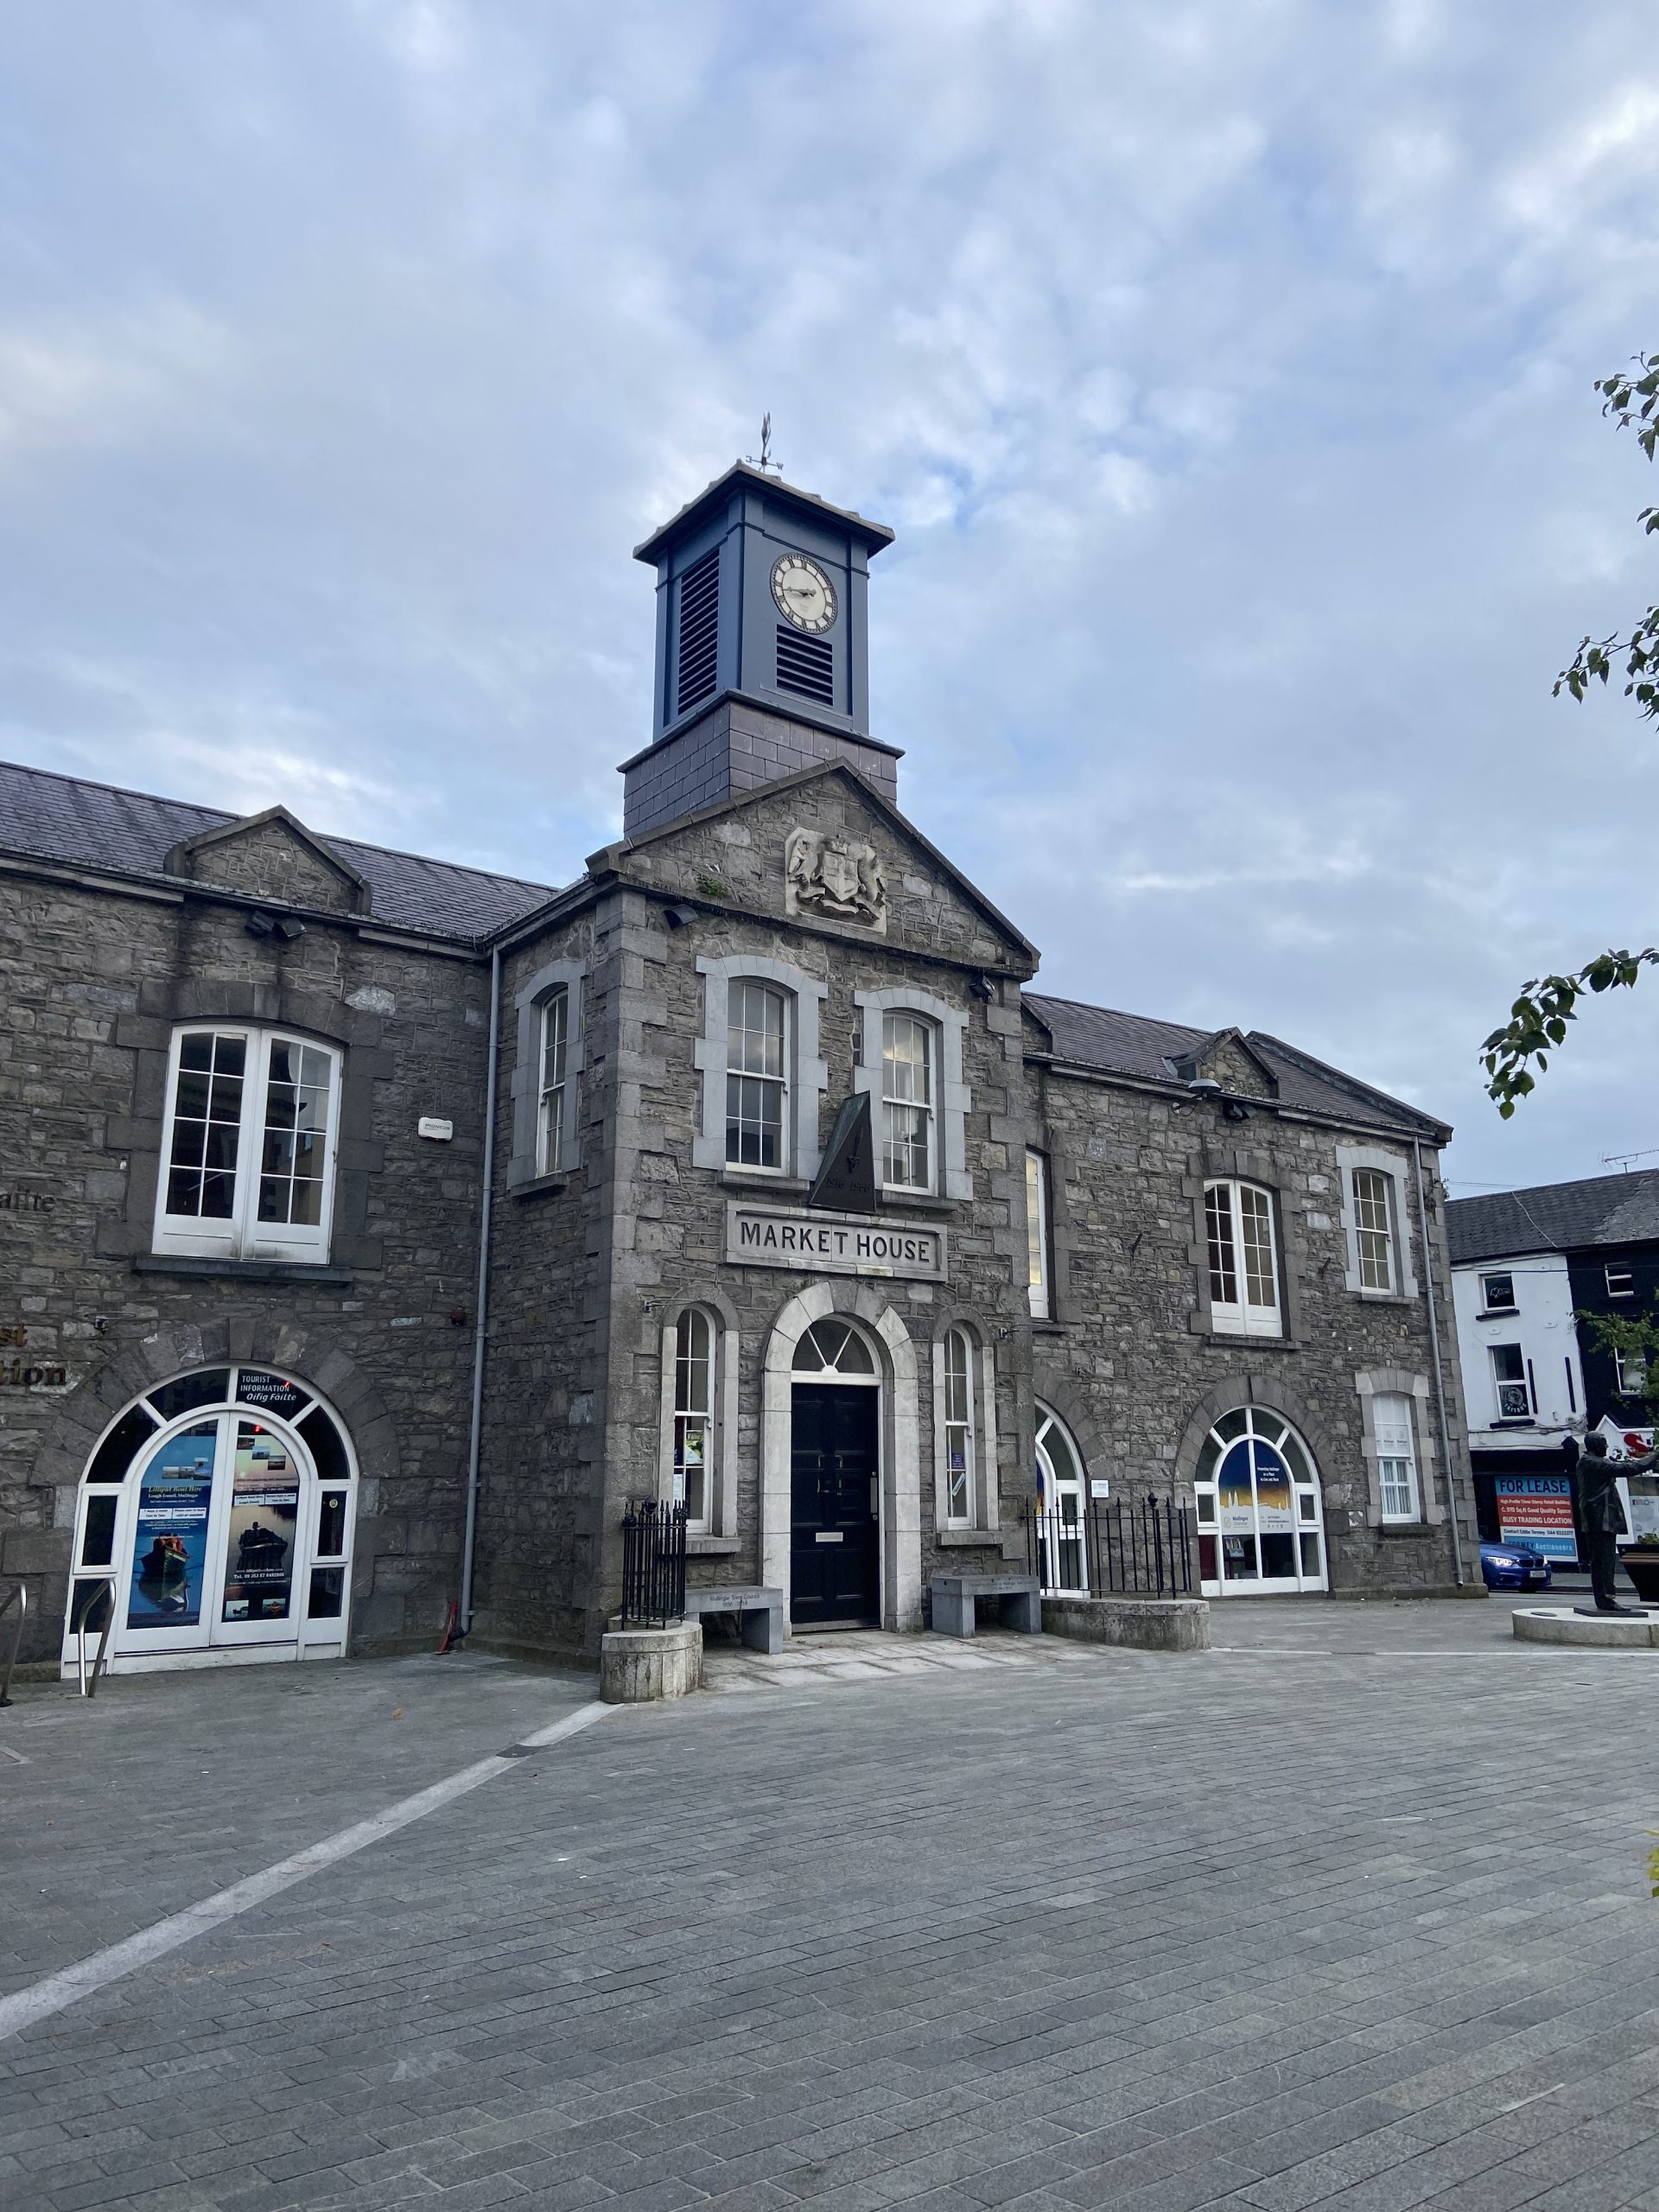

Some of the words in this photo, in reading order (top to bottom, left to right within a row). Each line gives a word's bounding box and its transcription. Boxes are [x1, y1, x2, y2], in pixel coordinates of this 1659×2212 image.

[741, 1222, 849, 1254] MARKET
[856, 1234, 930, 1263] HOUSE
[242, 1375, 270, 1383] TOURIST
[246, 1393, 269, 1402] Oifig
[1499, 1479, 1524, 1493] FOR
[1527, 1479, 1568, 1493] LEASE
